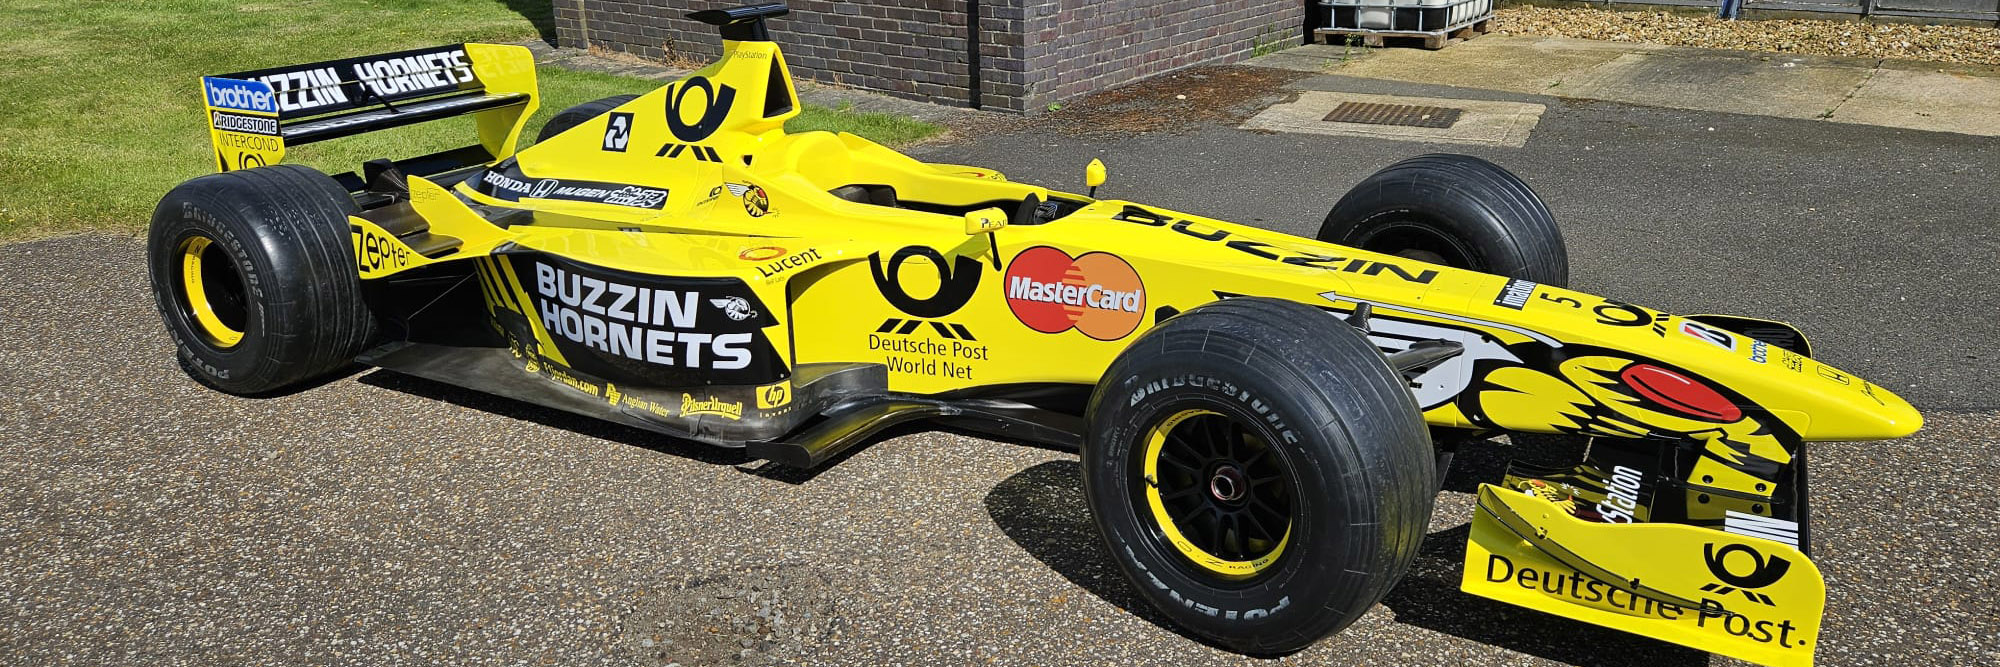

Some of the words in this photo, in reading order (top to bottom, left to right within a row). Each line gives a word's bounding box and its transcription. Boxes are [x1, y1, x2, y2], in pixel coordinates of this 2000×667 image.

[353, 50, 474, 96] HORNETS
[210, 81, 272, 111] brother
[215, 112, 277, 133] BRIDGESTONE
[219, 133, 279, 152] INTERCOND
[484, 171, 532, 193] HONDA
[555, 186, 611, 199] MUGEN
[1111, 204, 1439, 284] BUZZIN
[755, 248, 822, 278] Lucent
[535, 261, 699, 329] BUZZIN
[1009, 275, 1141, 313] MasterCard
[1540, 292, 1582, 309] 5
[541, 299, 752, 370] HORNETS
[868, 333, 947, 356] Deutsche
[952, 341, 989, 361] Post
[886, 355, 937, 377] World
[943, 361, 973, 380] Net
[622, 393, 648, 411] Anglian
[649, 401, 670, 418] Water
[767, 385, 784, 407] hp
[1594, 465, 1642, 524] Station
